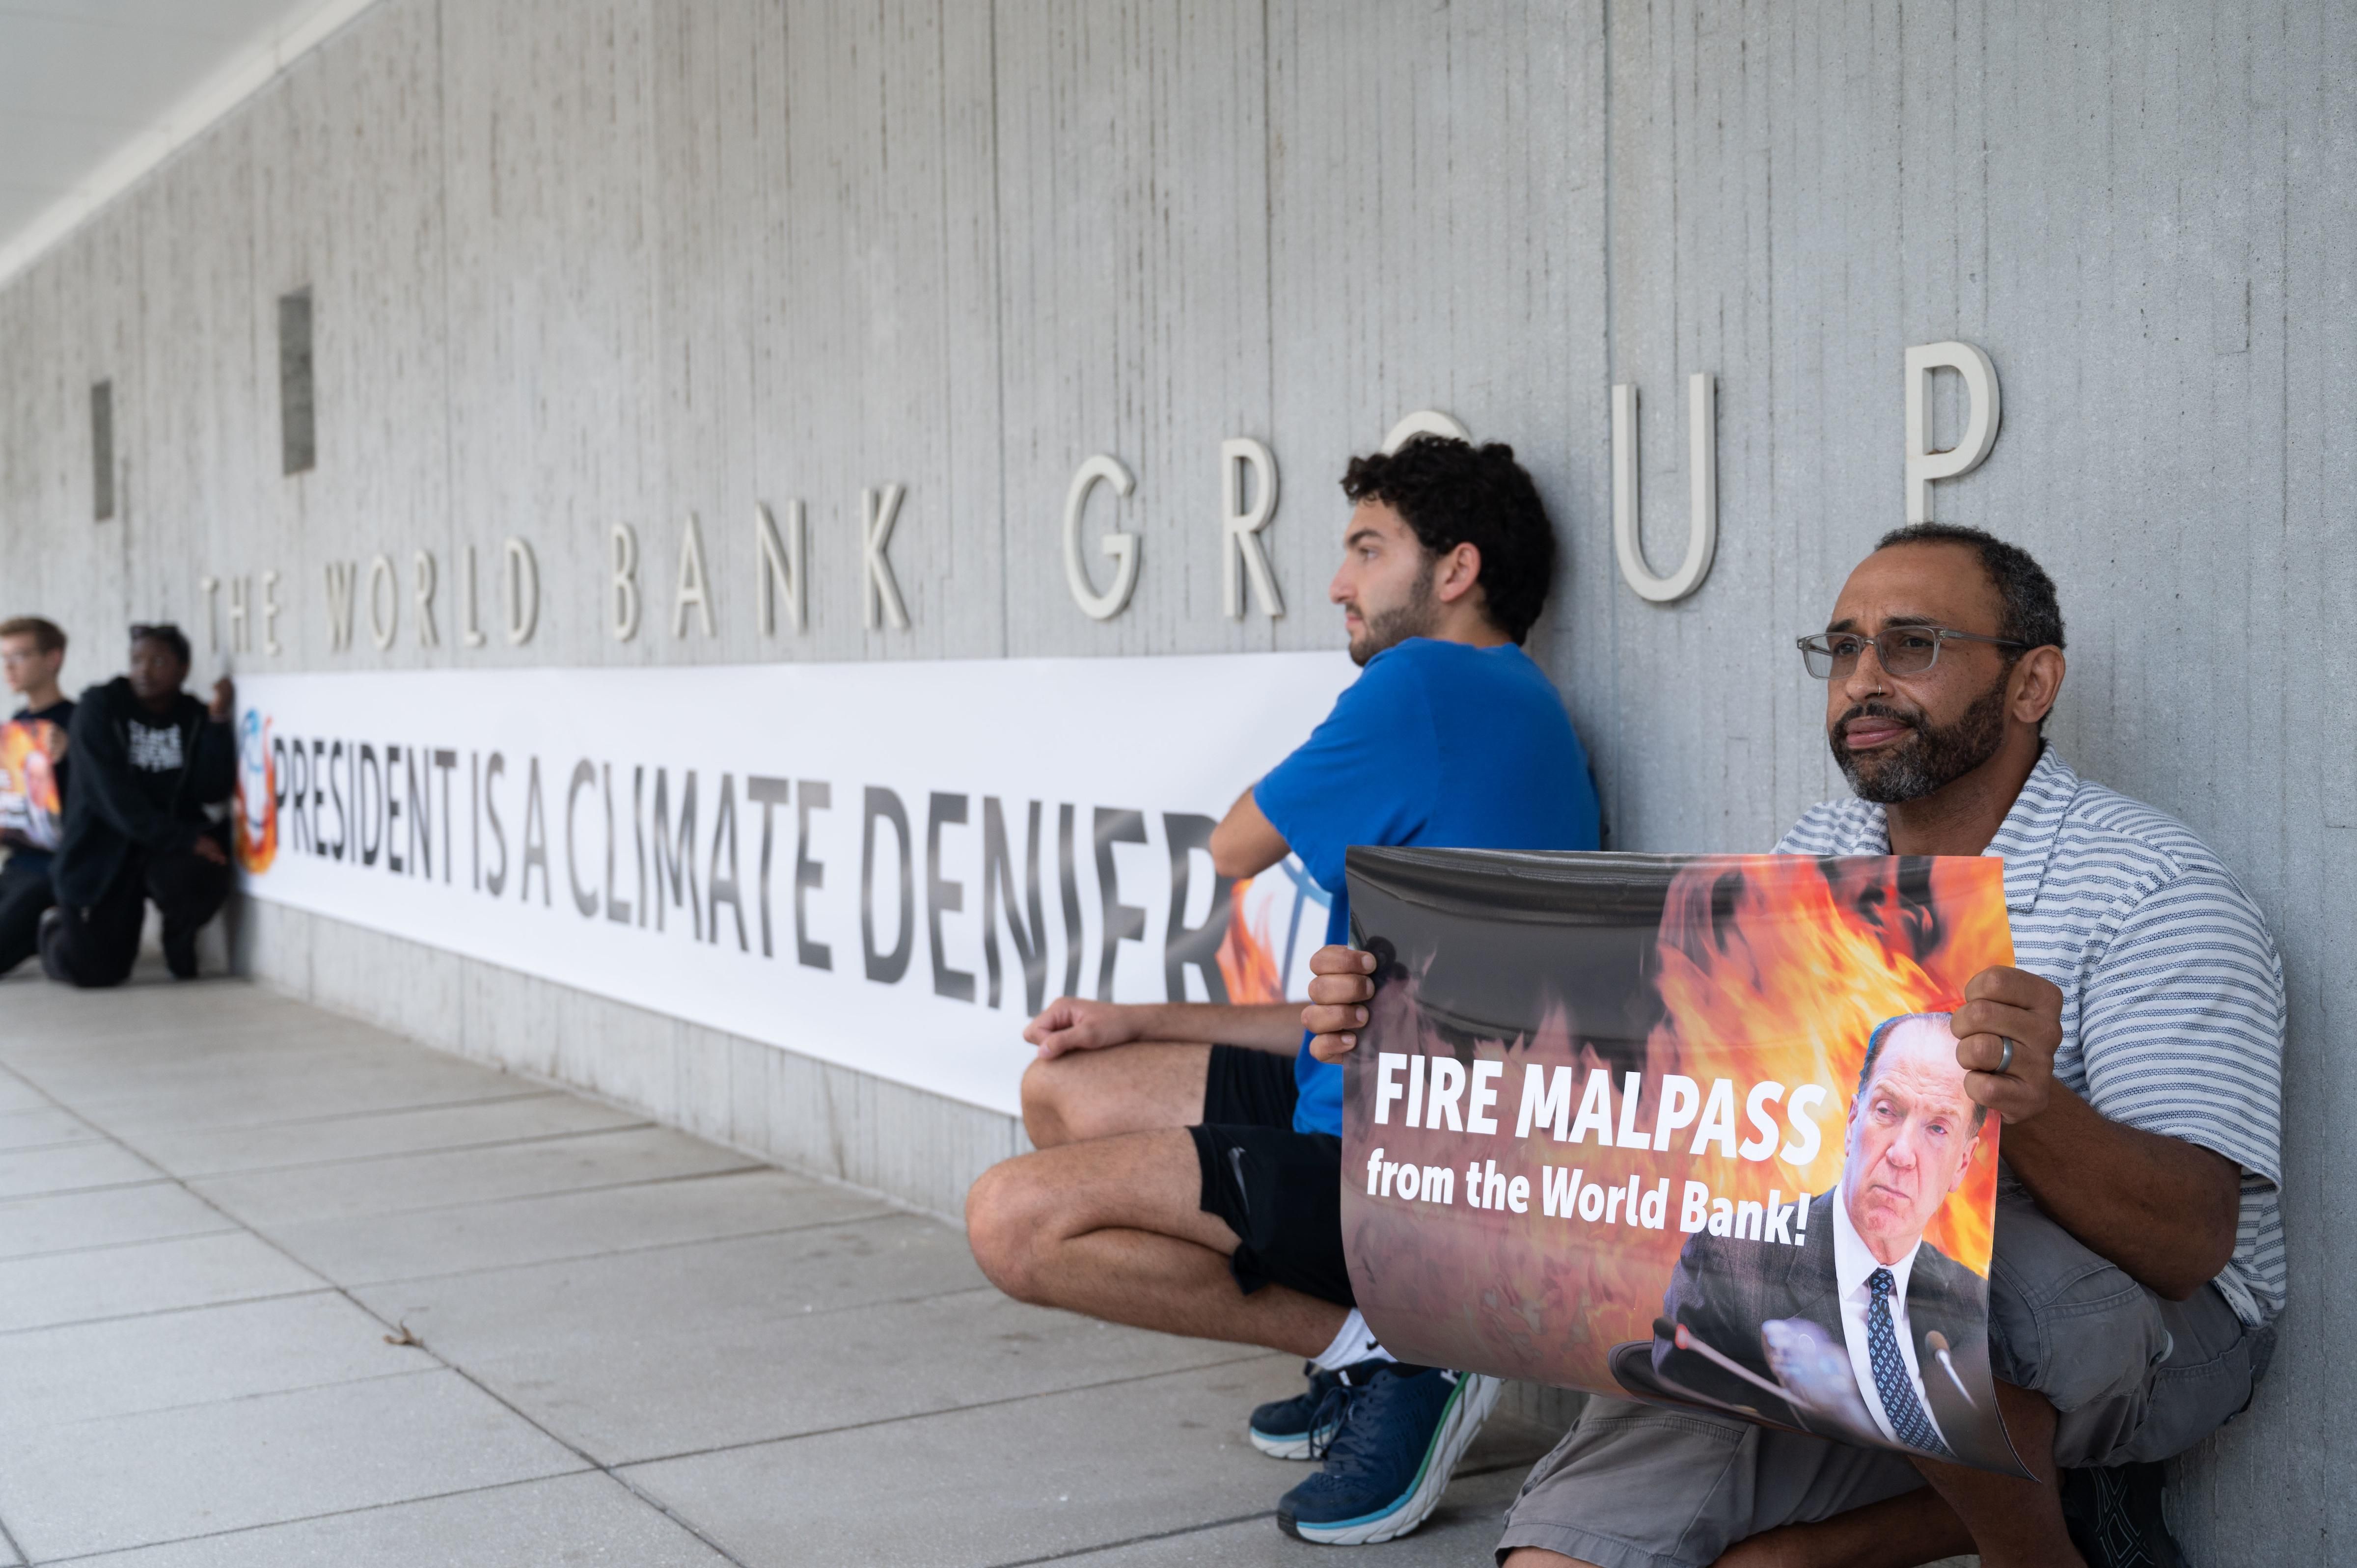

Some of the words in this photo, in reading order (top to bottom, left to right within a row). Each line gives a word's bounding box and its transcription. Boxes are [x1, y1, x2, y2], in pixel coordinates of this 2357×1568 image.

[200, 569, 281, 656] THE
[324, 537, 542, 653] WORLD
[610, 483, 912, 642] BANK
[1063, 340, 2050, 621] GRUP
[274, 735, 458, 886] PRESIDENT
[471, 750, 508, 897] IS
[521, 756, 552, 908] A
[566, 757, 833, 973] CLIMATE
[861, 784, 1233, 1018] DENIER
[1367, 1148, 1454, 1205] from
[1466, 1159, 1531, 1214] the
[1542, 1164, 1670, 1230] World
[1679, 1179, 1811, 1246] Bank!
[1374, 1052, 1503, 1135] FIRE
[1514, 1063, 1828, 1166] MALPASS
